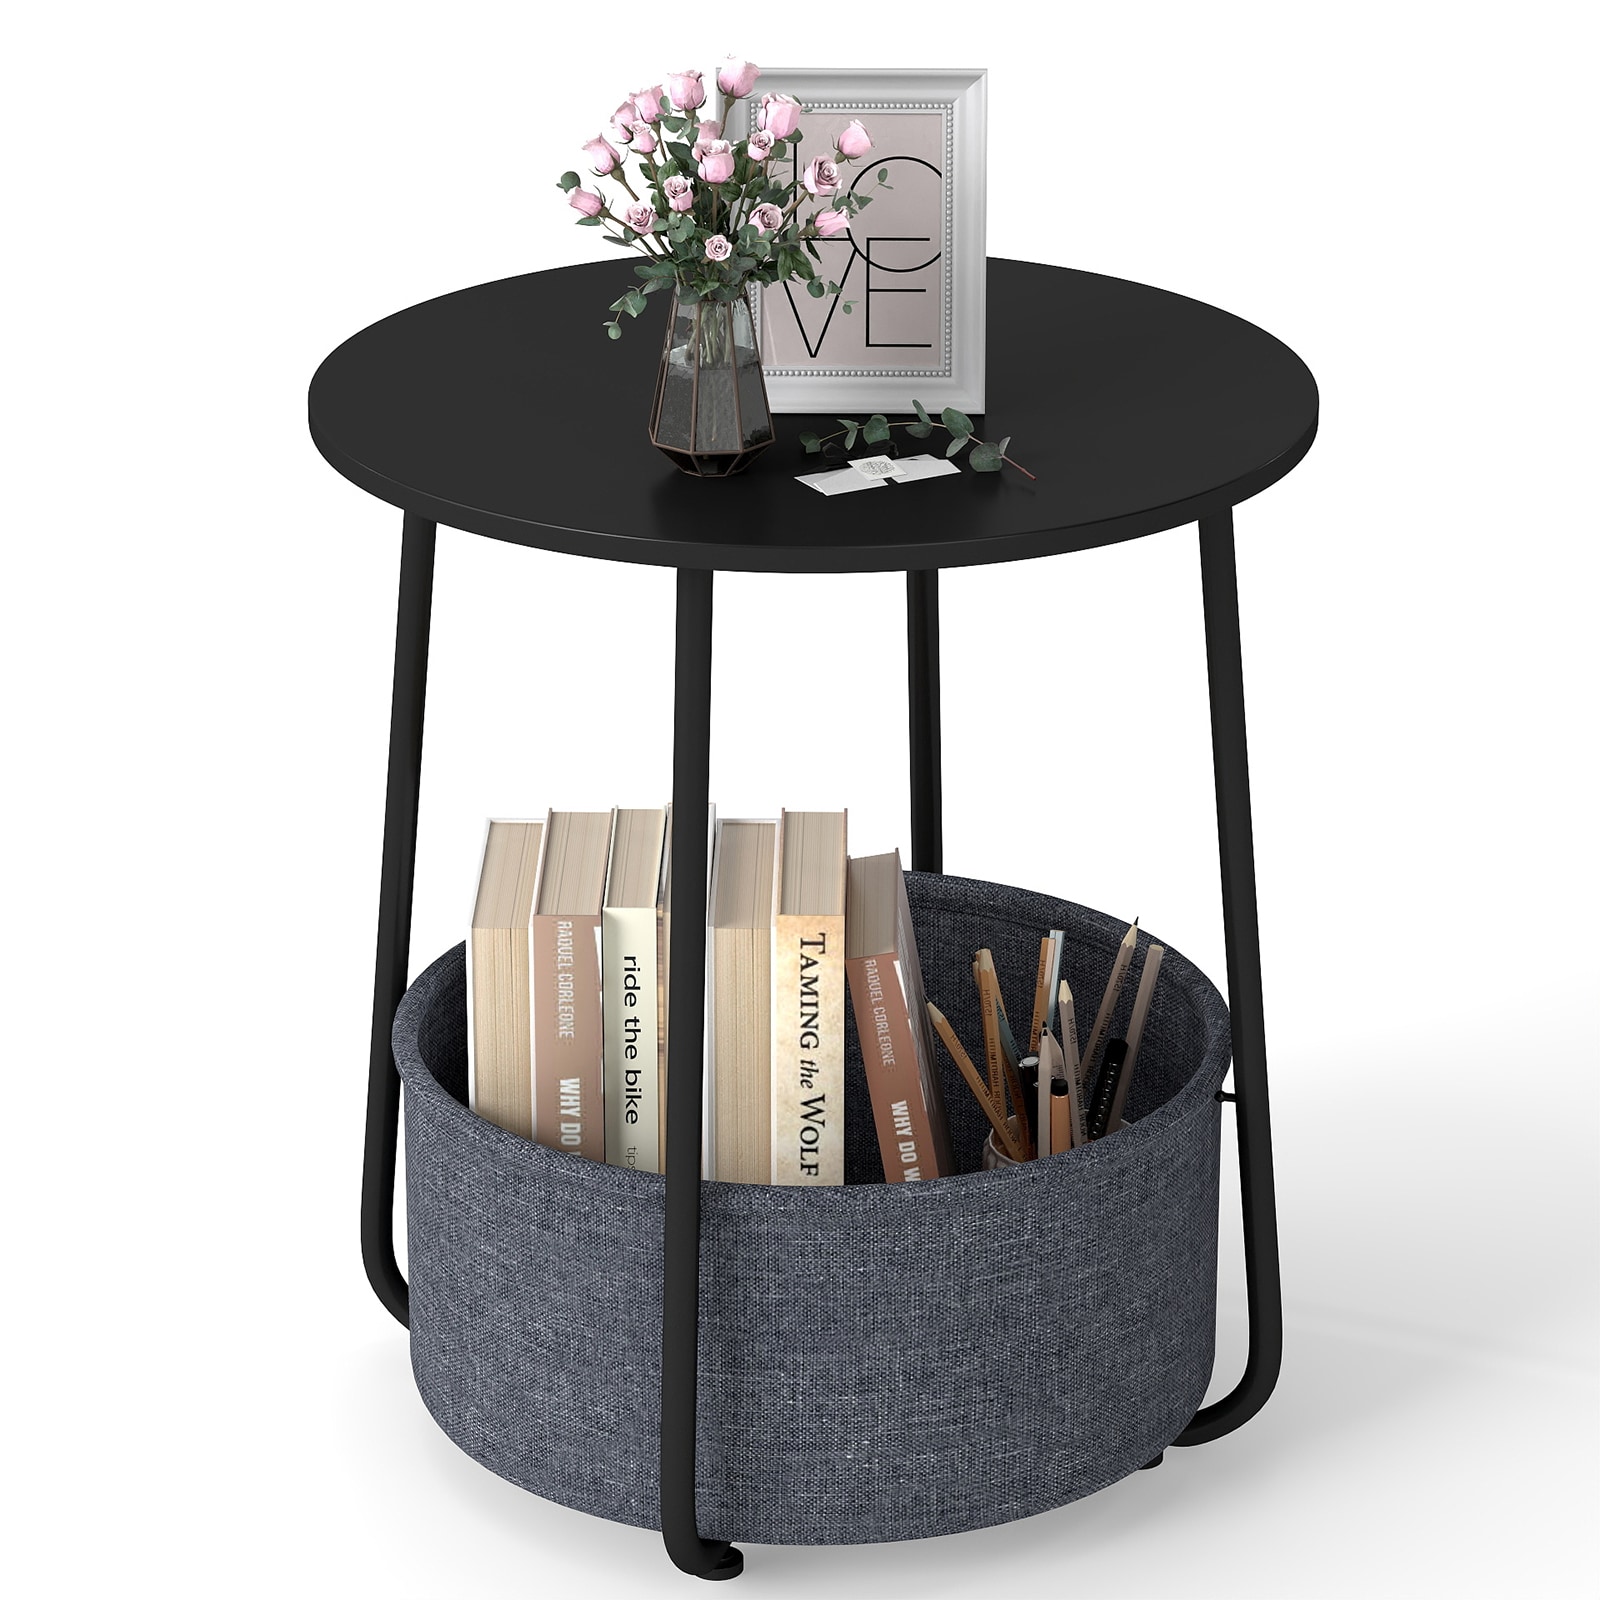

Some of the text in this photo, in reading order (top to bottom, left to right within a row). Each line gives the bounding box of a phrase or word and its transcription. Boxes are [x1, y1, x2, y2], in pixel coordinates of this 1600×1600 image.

[557, 921, 575, 1039] RAQUEL CORLEONE
[623, 956, 642, 1124] ride the bike
[800, 932, 826, 1177] TAMING the WOLF
[873, 1006, 896, 1067] CORLEONE
[559, 1077, 581, 1117] WHY
[891, 1100, 913, 1136] WHY
[560, 1122, 581, 1146] DO
[898, 1141, 917, 1163] DO
